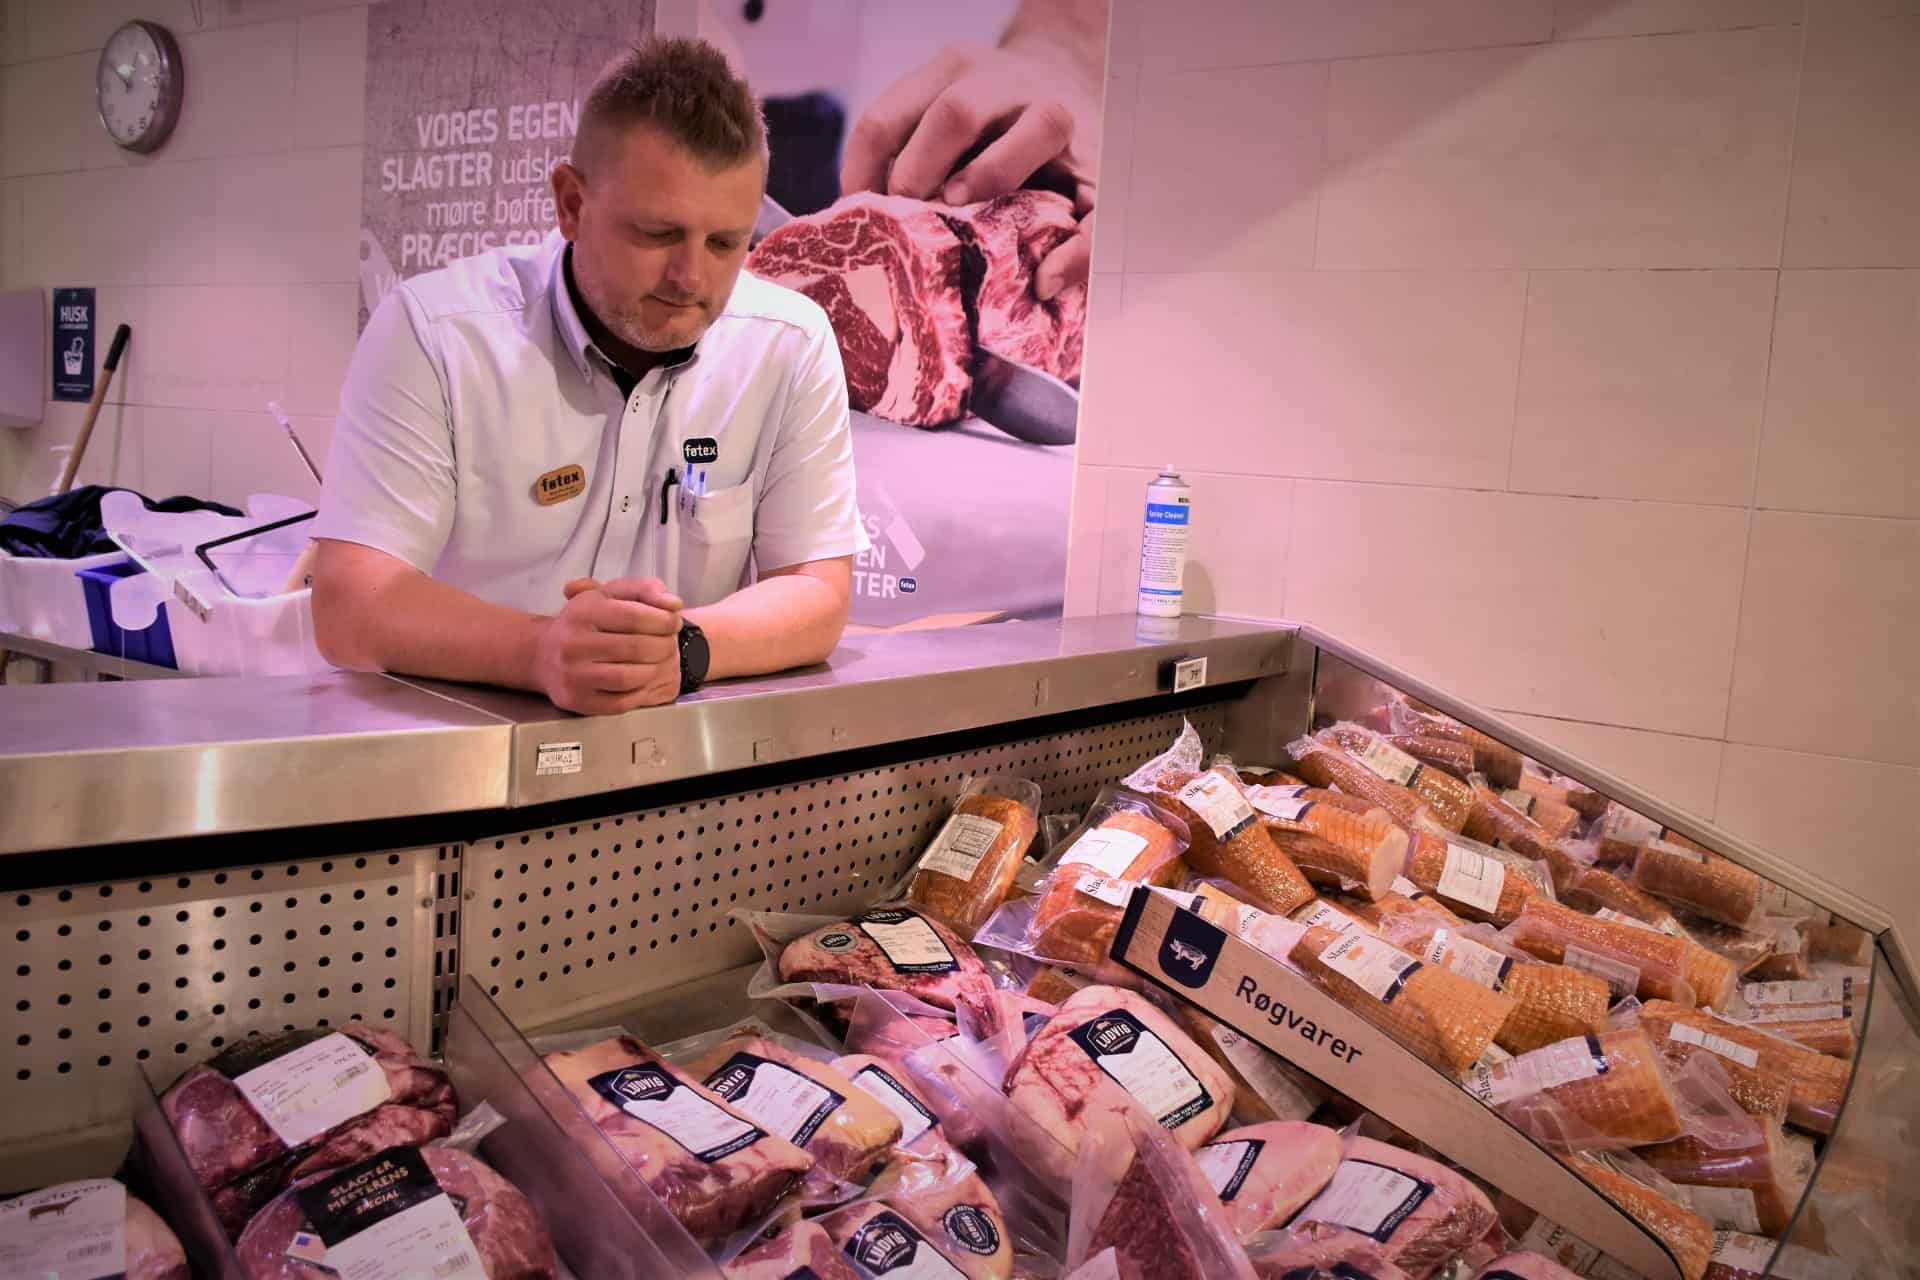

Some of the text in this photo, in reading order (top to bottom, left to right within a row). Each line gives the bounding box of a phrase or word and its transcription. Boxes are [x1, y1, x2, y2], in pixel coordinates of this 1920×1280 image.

[416, 101, 578, 149] VORES EGEN
[381, 151, 493, 191] SLAGTER
[427, 200, 486, 226] møre
[61, 305, 88, 322] HUSK
[856, 544, 886, 569] EN
[851, 570, 897, 599] TER
[1236, 975, 1362, 1063] Røgvarer
[1095, 1022, 1133, 1048] LUDVIG
[621, 1074, 666, 1096] LUDVIG
[866, 1231, 907, 1266] LUDVIG
